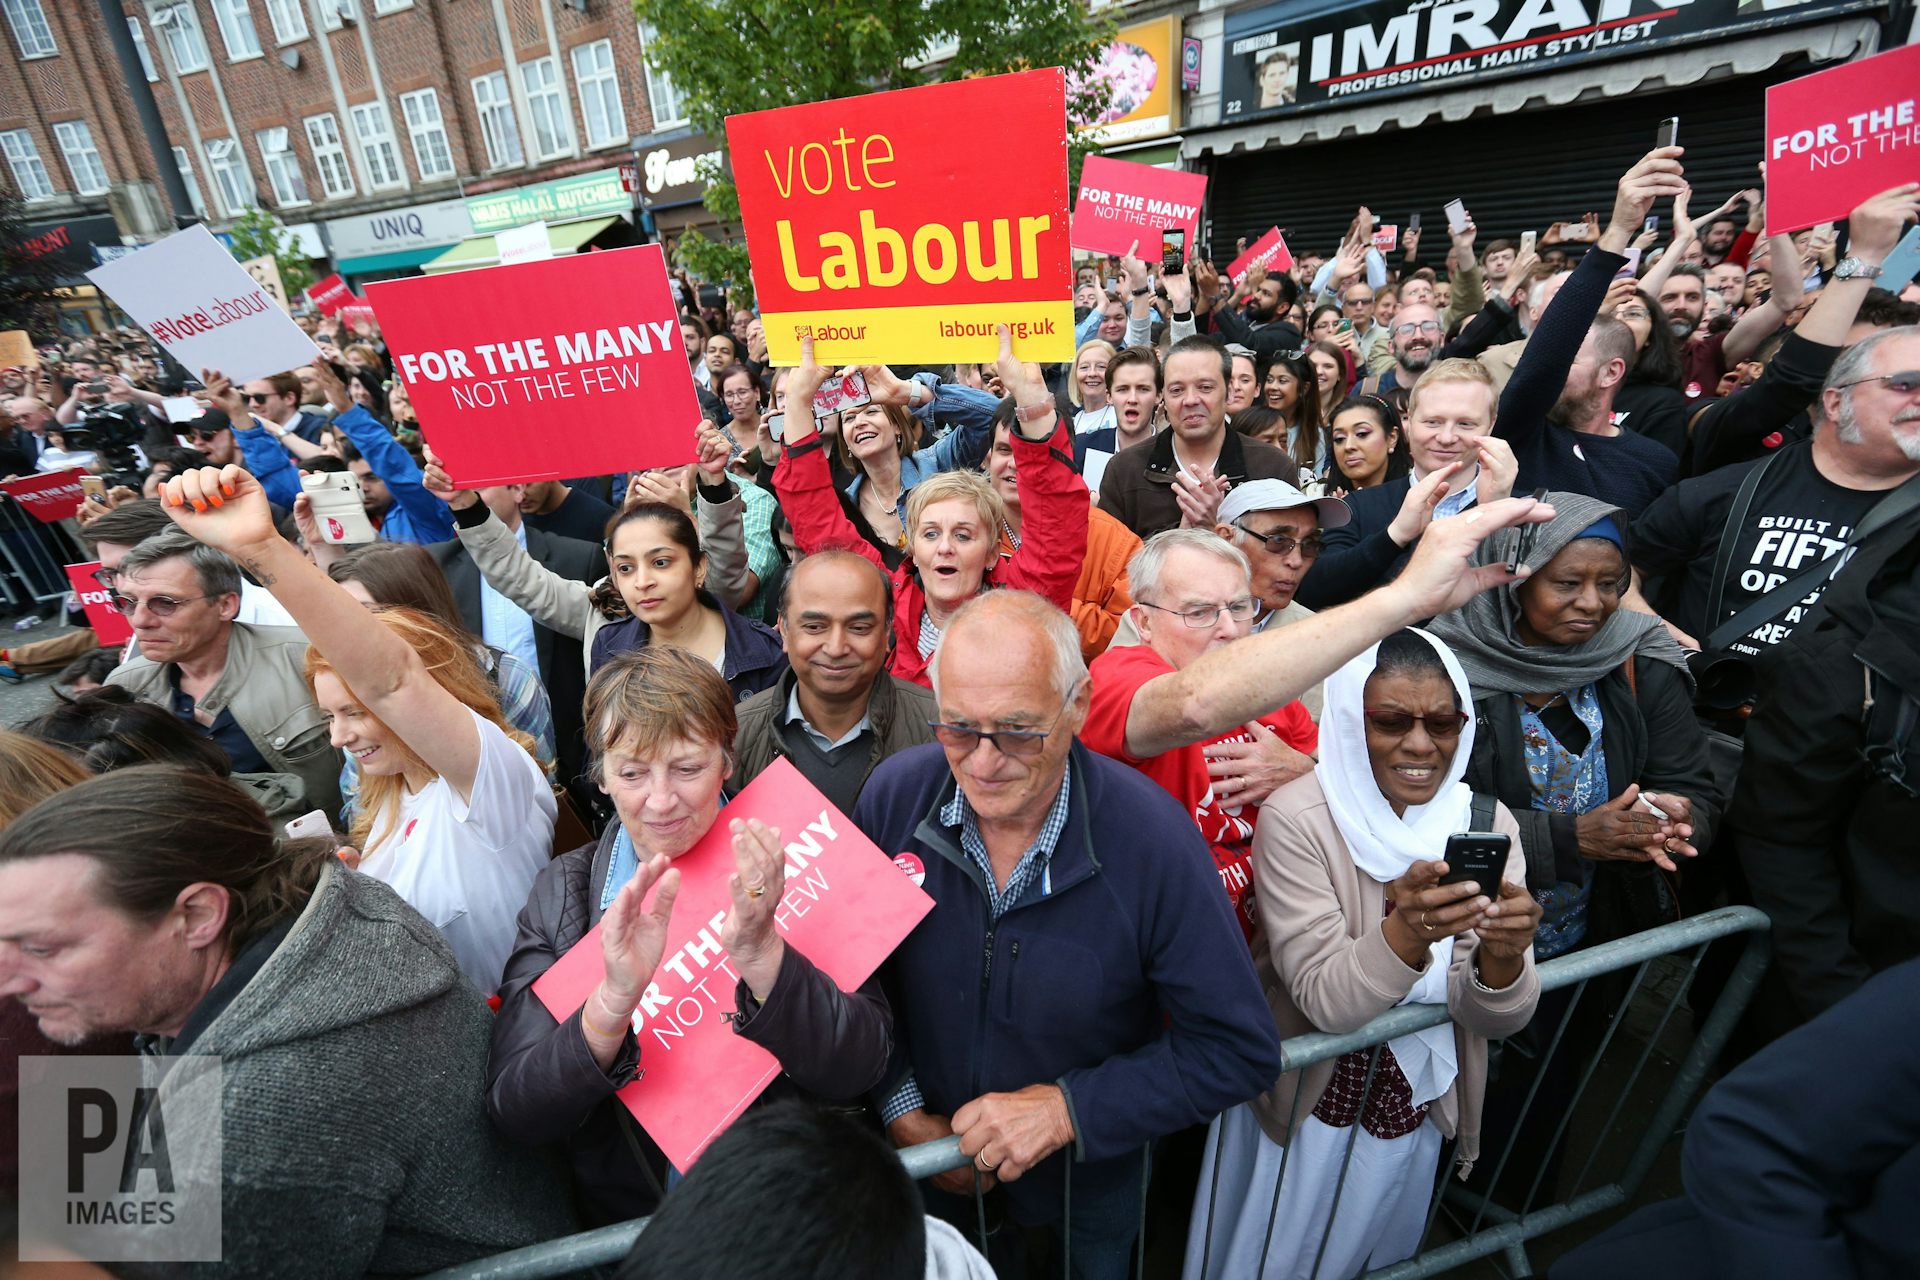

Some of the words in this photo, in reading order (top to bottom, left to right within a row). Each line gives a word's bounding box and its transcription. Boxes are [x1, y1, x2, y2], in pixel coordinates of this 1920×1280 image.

[1328, 57, 1477, 97] PROFESSIONAL
[1480, 44, 1539, 69] HAIR
[1544, 20, 1659, 56] STYLIST
[1227, 100, 1242, 114] 22
[1772, 122, 1839, 160] FOR
[1848, 99, 1915, 138] THE
[764, 127, 897, 199] vote
[1810, 138, 1868, 171] NOT
[510, 194, 556, 216] HALAL
[1080, 187, 1111, 206] FOR
[1114, 193, 1144, 212] THE
[1146, 199, 1197, 221] MANY
[1094, 204, 1121, 220] NOT
[1123, 211, 1147, 226] THE
[1149, 215, 1177, 231] FEW
[370, 212, 425, 240] UNIQ
[775, 209, 1051, 292] Labour
[150, 290, 269, 345] #VoteLabour
[808, 324, 867, 342] Labour
[399, 348, 475, 385] FOR
[474, 337, 550, 375] THE
[553, 319, 675, 366] MANY
[450, 379, 509, 411] NOT
[514, 371, 575, 402] THE
[580, 362, 641, 395] FEW
[61, 481, 83, 495] MA
[1758, 515, 1832, 534] BUILT
[1837, 526, 1854, 540] I
[783, 809, 838, 880] ANY
[652, 976, 717, 1050] NOT
[773, 866, 831, 931] FEW
